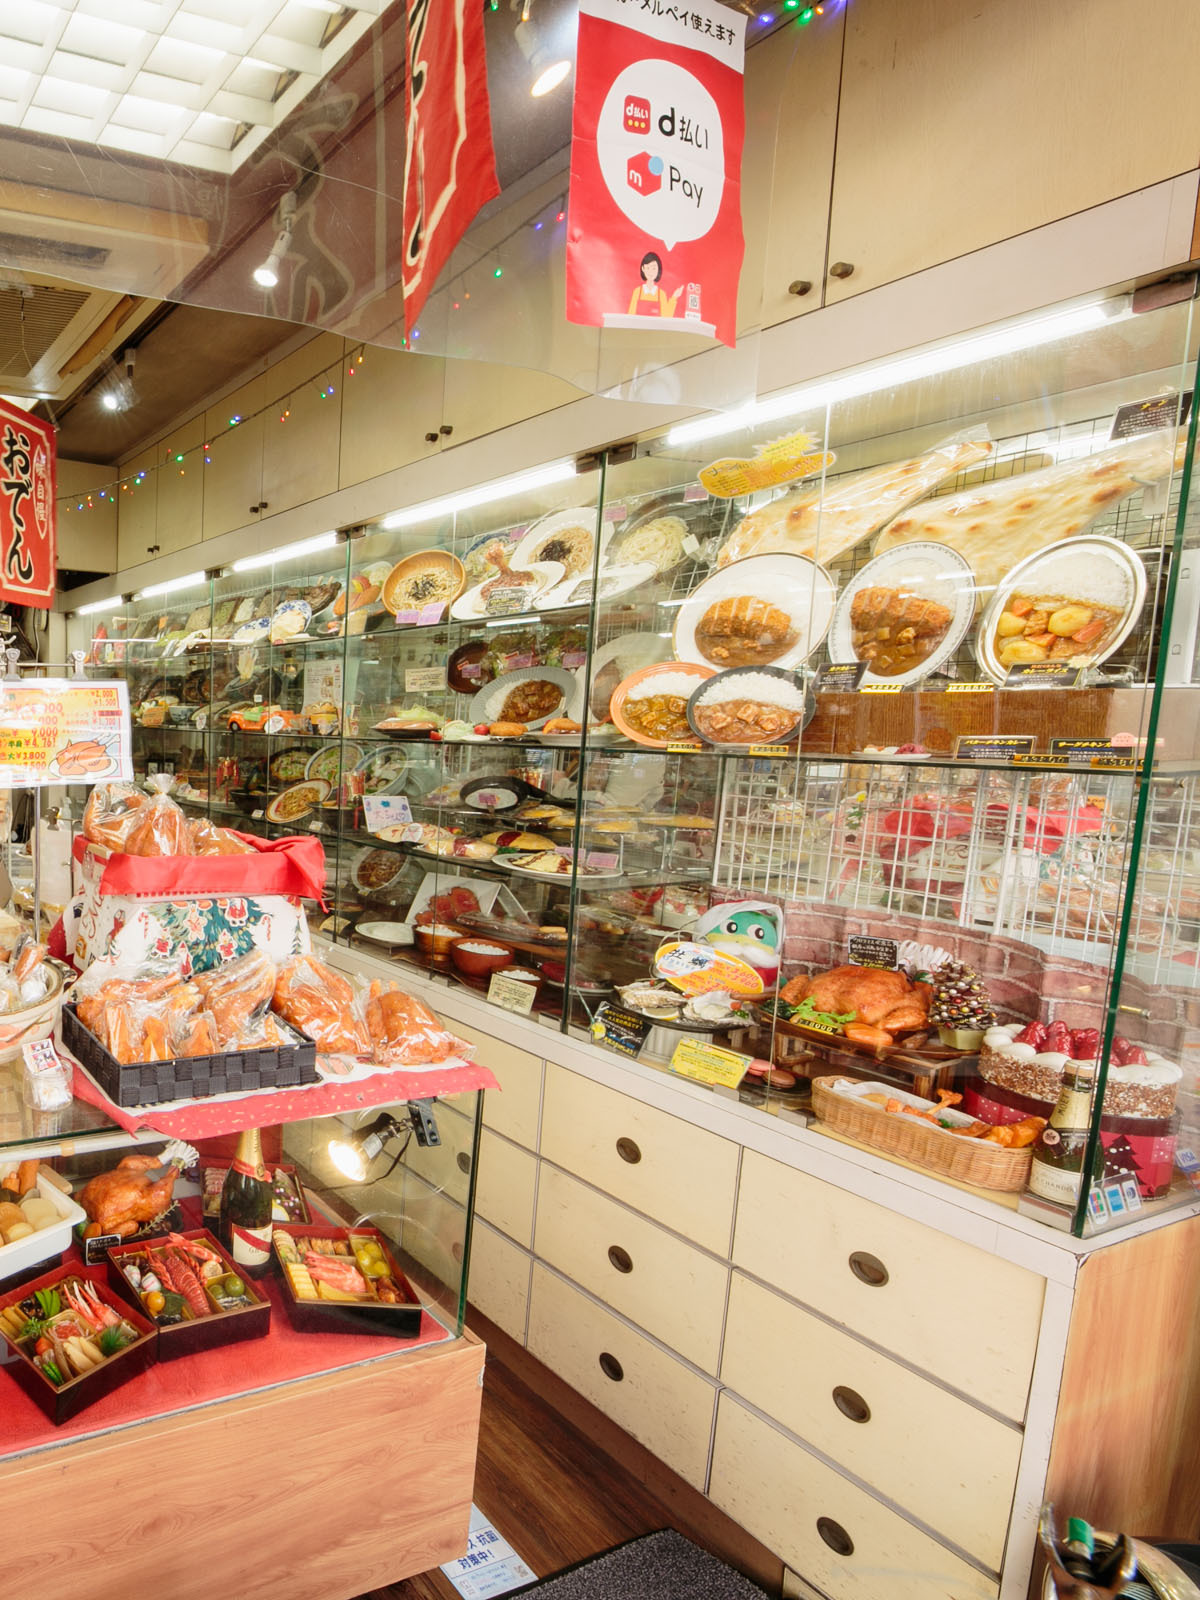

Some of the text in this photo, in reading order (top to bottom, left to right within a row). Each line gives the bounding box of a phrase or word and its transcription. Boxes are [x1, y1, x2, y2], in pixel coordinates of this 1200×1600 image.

[626, 104, 648, 119] d払い
[658, 107, 708, 149] d払い
[669, 166, 703, 208] Pay
[1, 426, 33, 584] おでん
[476, 1530, 499, 1547] 抗菌
[457, 1549, 497, 1570] 対策中!
